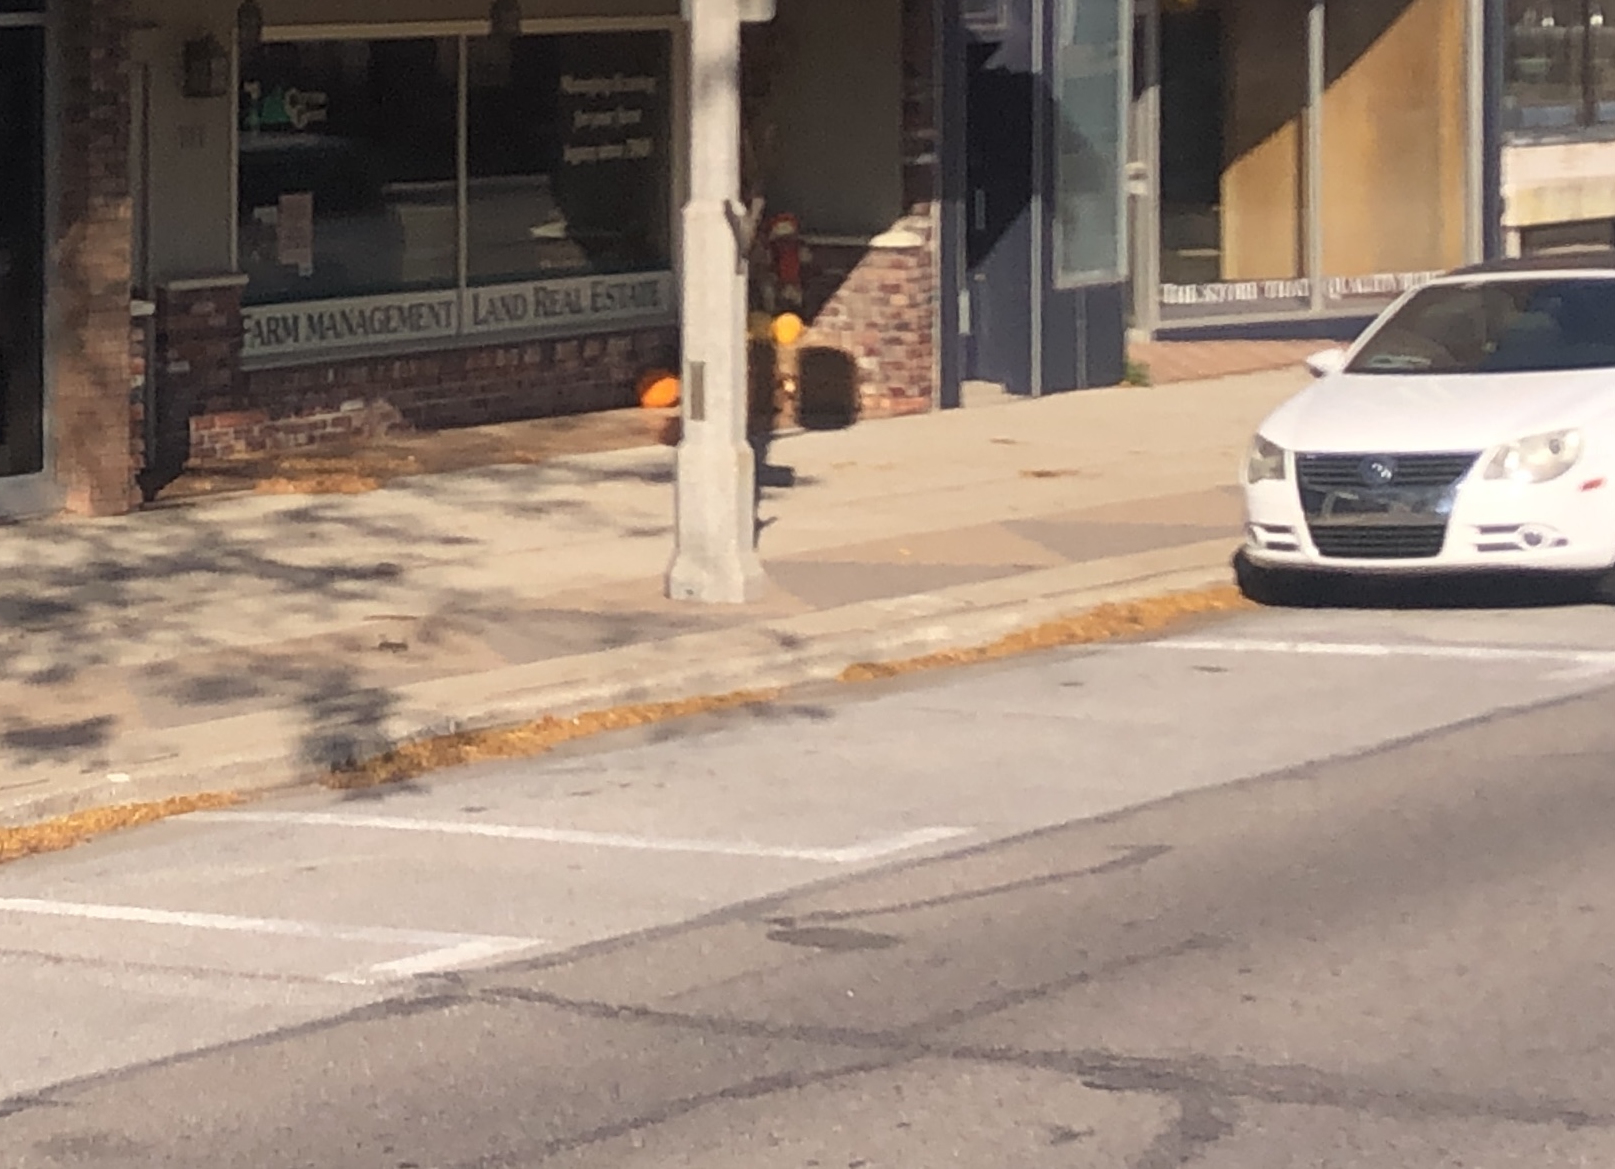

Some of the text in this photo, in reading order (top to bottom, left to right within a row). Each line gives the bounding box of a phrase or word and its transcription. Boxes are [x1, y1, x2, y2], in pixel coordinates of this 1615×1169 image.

[304, 298, 456, 343] MANAGEMENT
[471, 278, 662, 327] LAND REAL ESTATE
